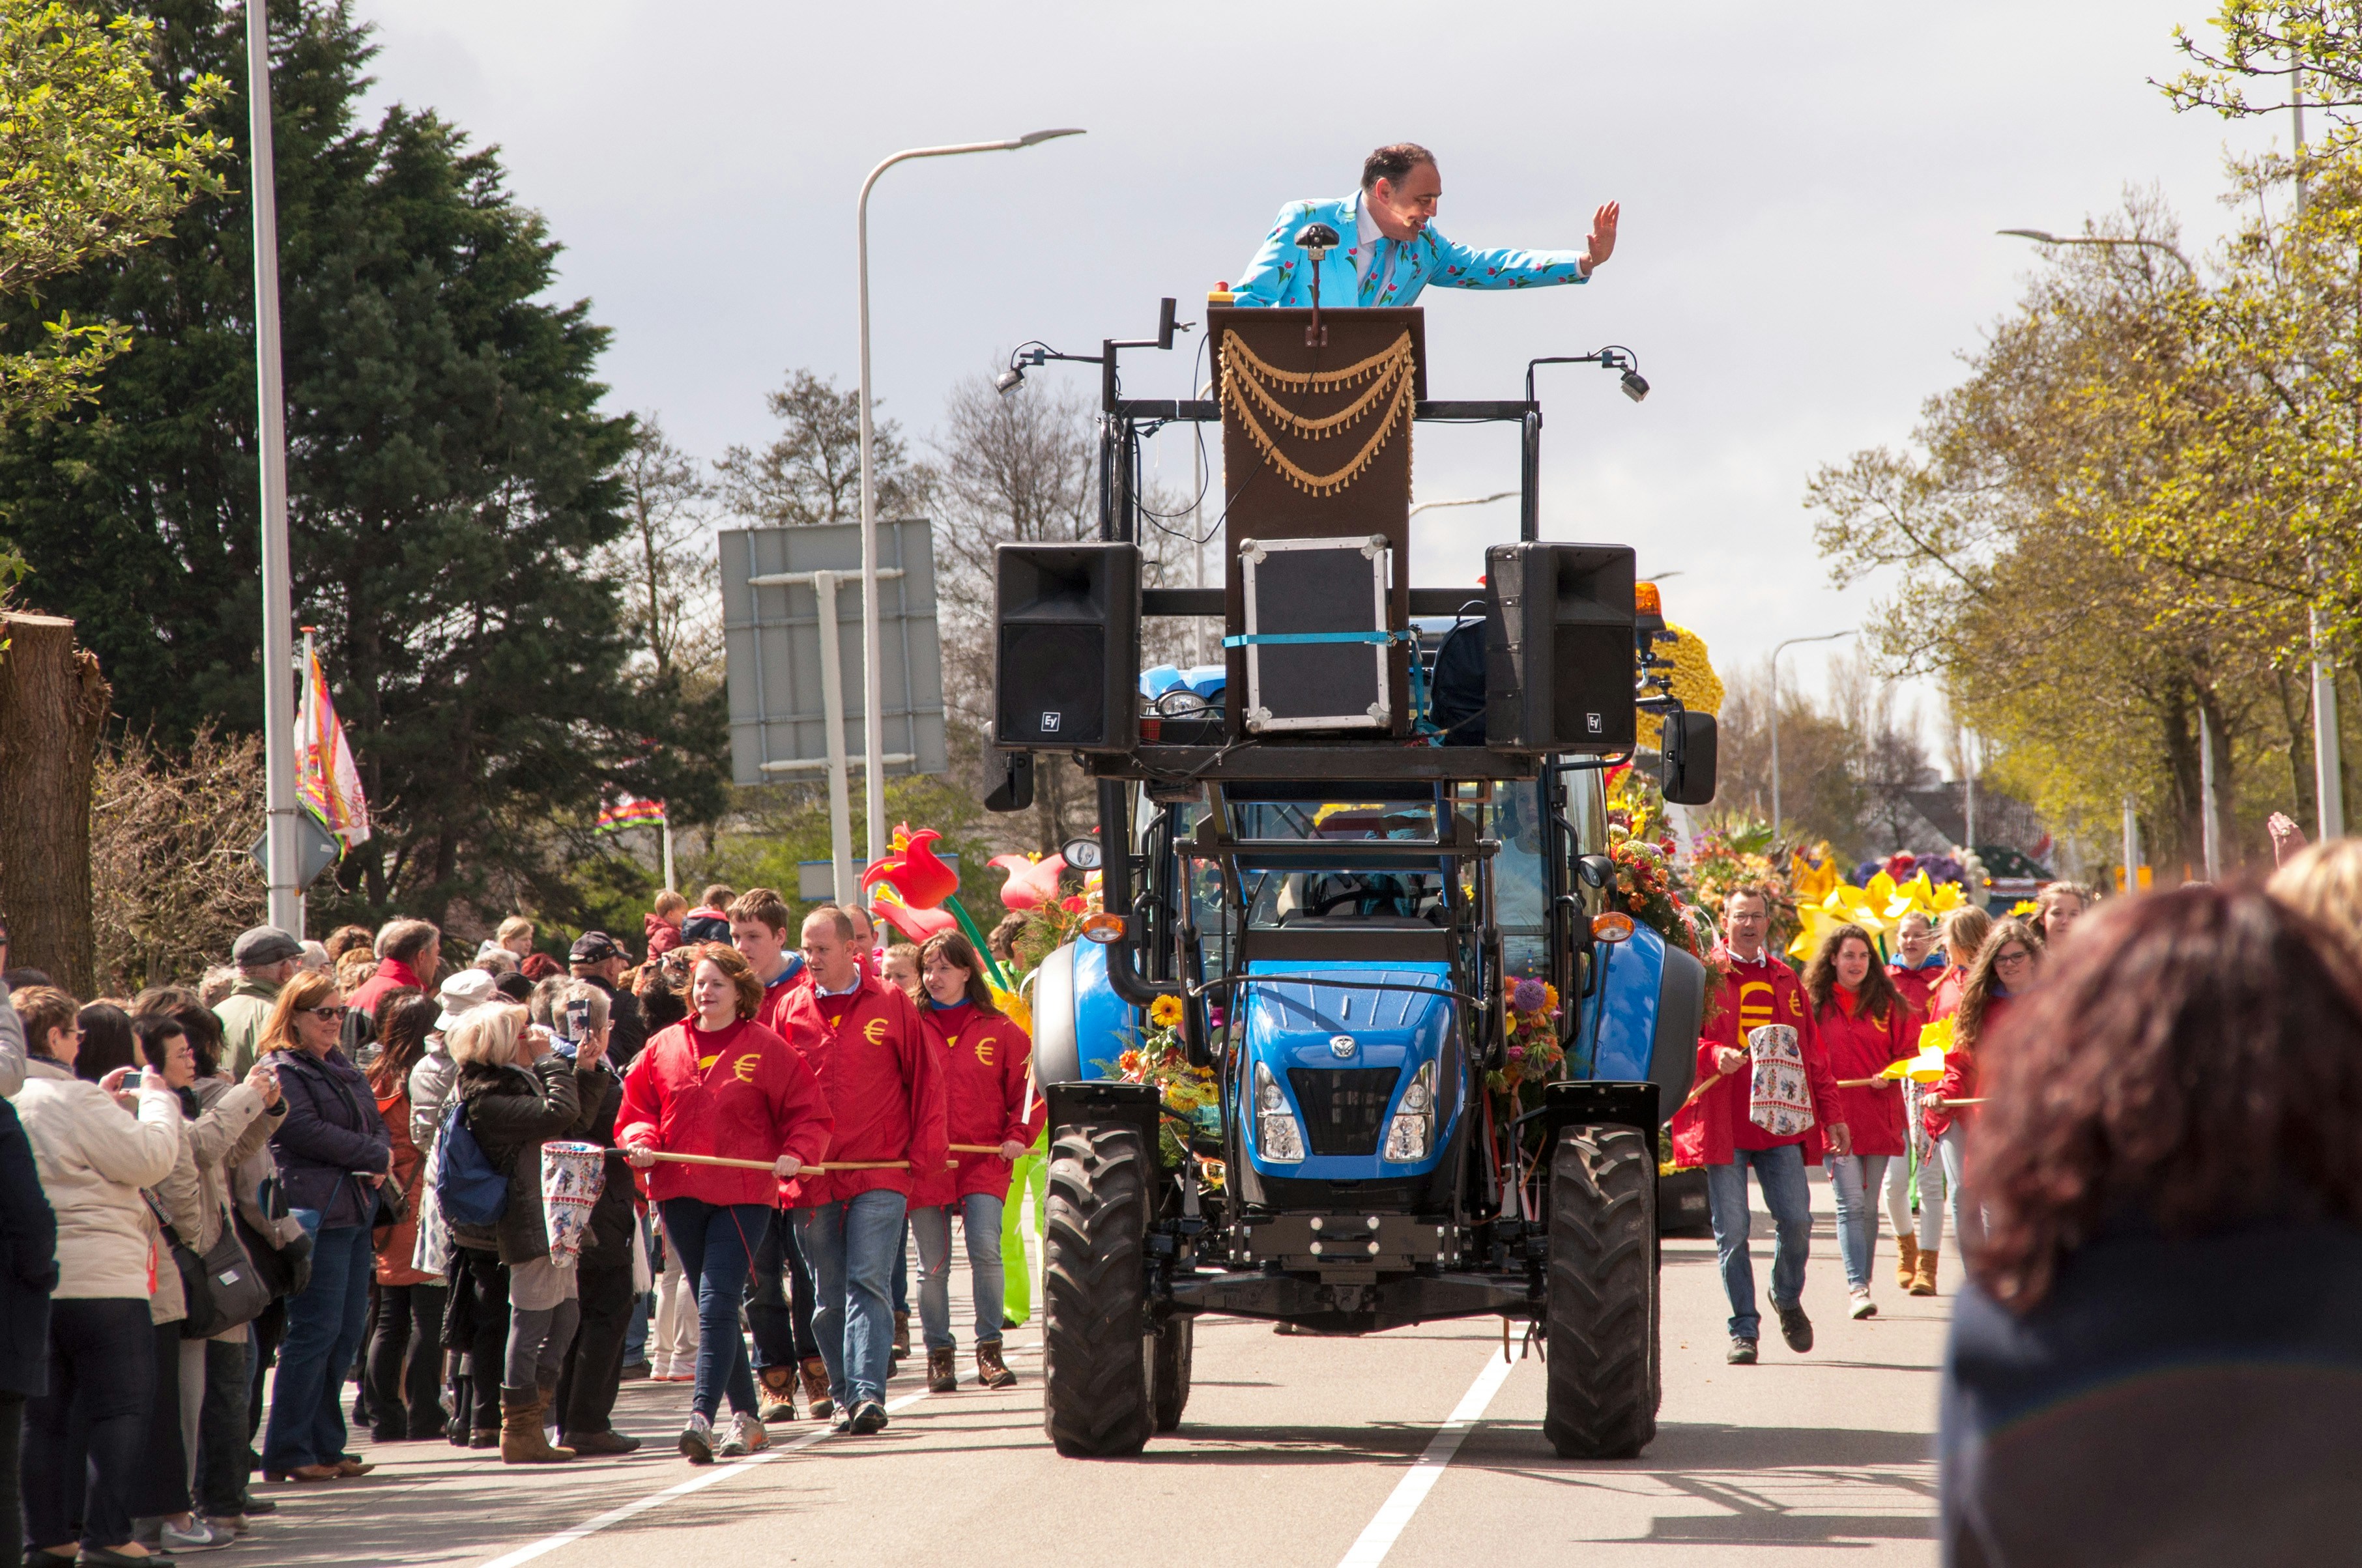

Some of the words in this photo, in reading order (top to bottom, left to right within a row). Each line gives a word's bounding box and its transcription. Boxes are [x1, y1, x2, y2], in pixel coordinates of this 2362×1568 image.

[1044, 715, 1058, 728] EV
[863, 1018, 889, 1046] €
[974, 1037, 996, 1066] €
[732, 1053, 762, 1083] €
